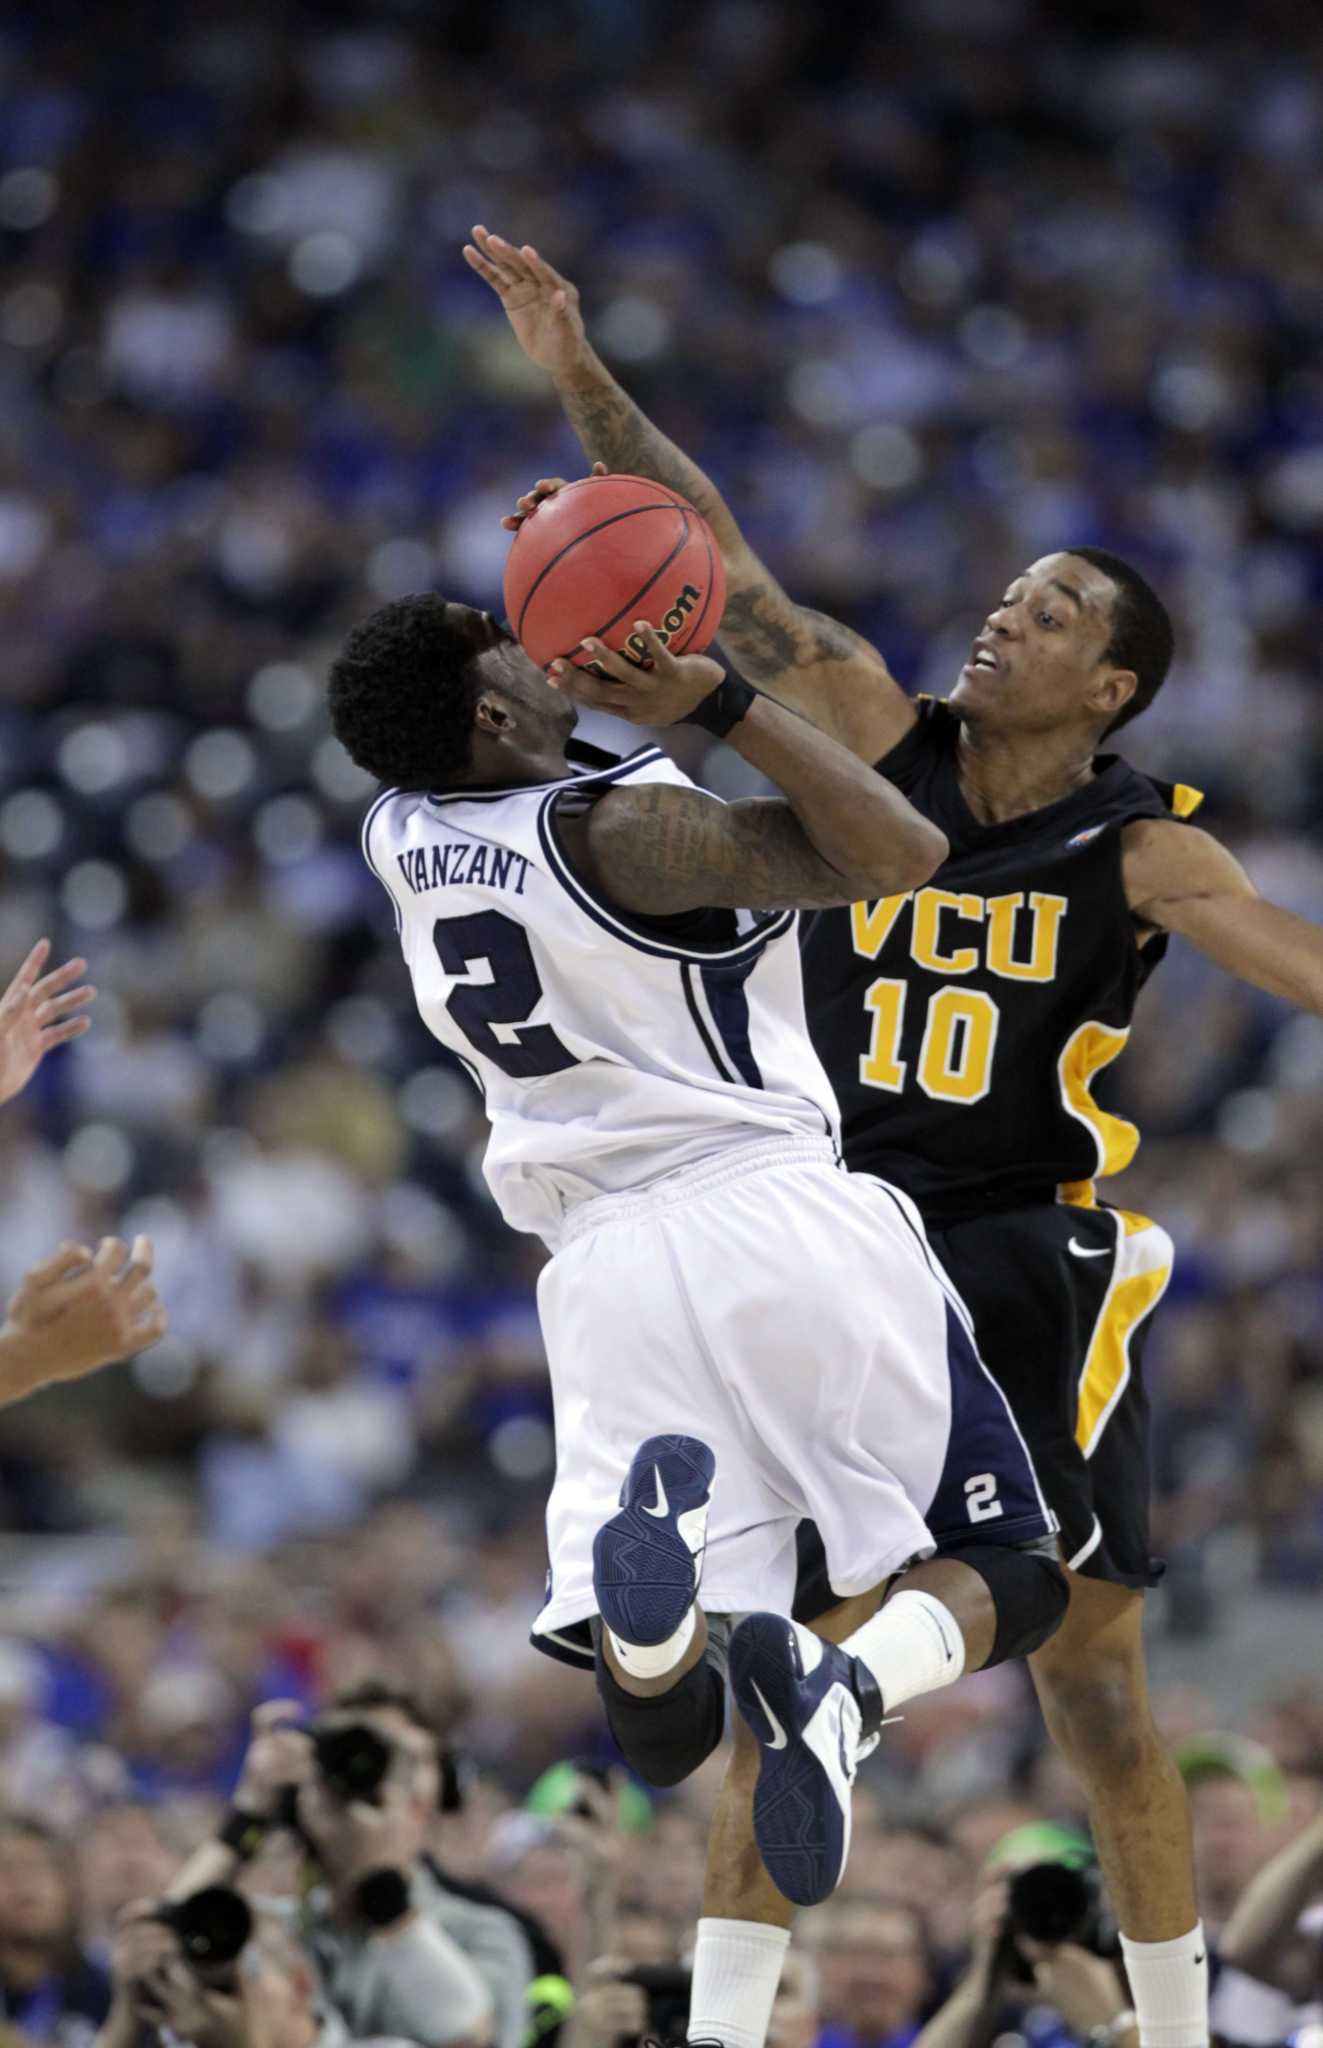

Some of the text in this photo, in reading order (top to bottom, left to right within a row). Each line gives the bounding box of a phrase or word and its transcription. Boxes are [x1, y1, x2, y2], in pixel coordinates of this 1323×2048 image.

[397, 844, 536, 895] VANZANT
[850, 886, 1068, 983] VCU
[432, 908, 583, 1079] 2
[858, 977, 1000, 1106] 10
[964, 1472, 1004, 1524] 2
